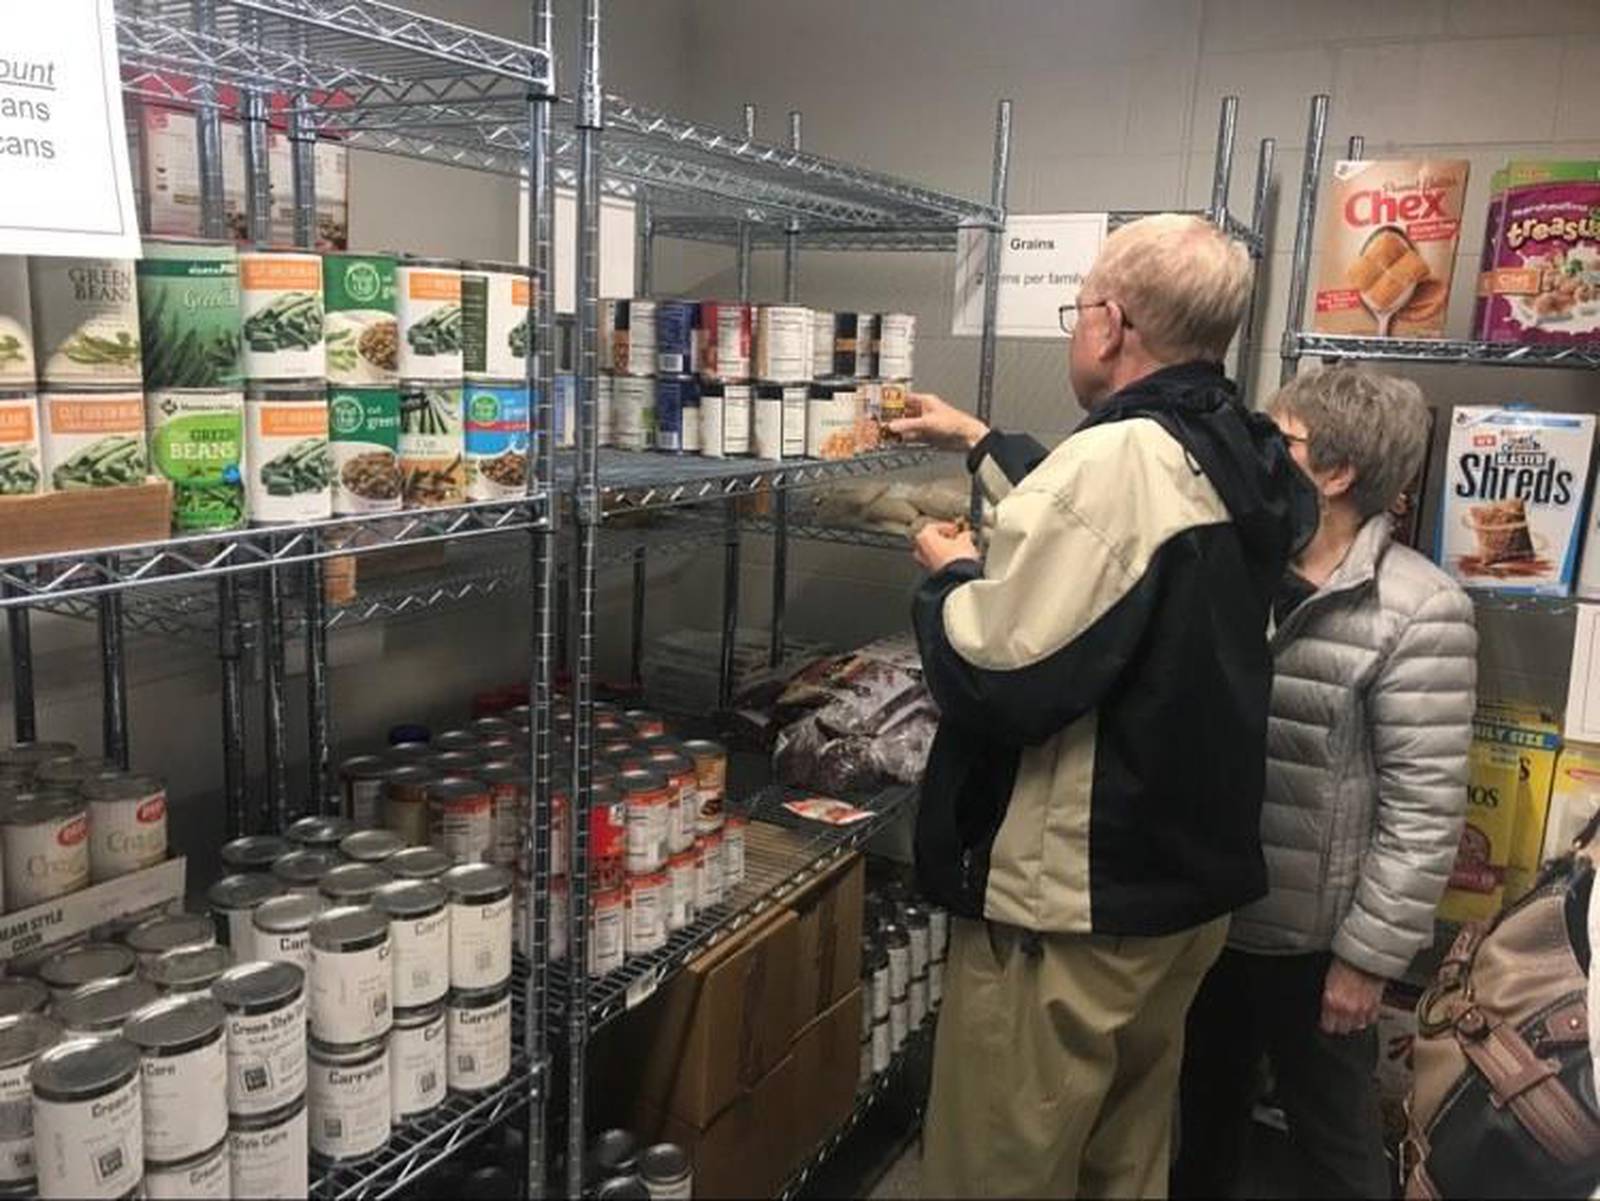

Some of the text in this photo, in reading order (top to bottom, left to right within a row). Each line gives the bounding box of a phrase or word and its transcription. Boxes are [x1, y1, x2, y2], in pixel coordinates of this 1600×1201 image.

[1344, 190, 1447, 228] Chex
[1010, 238, 1055, 251] Grains
[68, 267, 131, 287] GREEN
[1023, 274, 1045, 286] per
[169, 442, 238, 460] BEANS
[1456, 453, 1573, 506] Shreds
